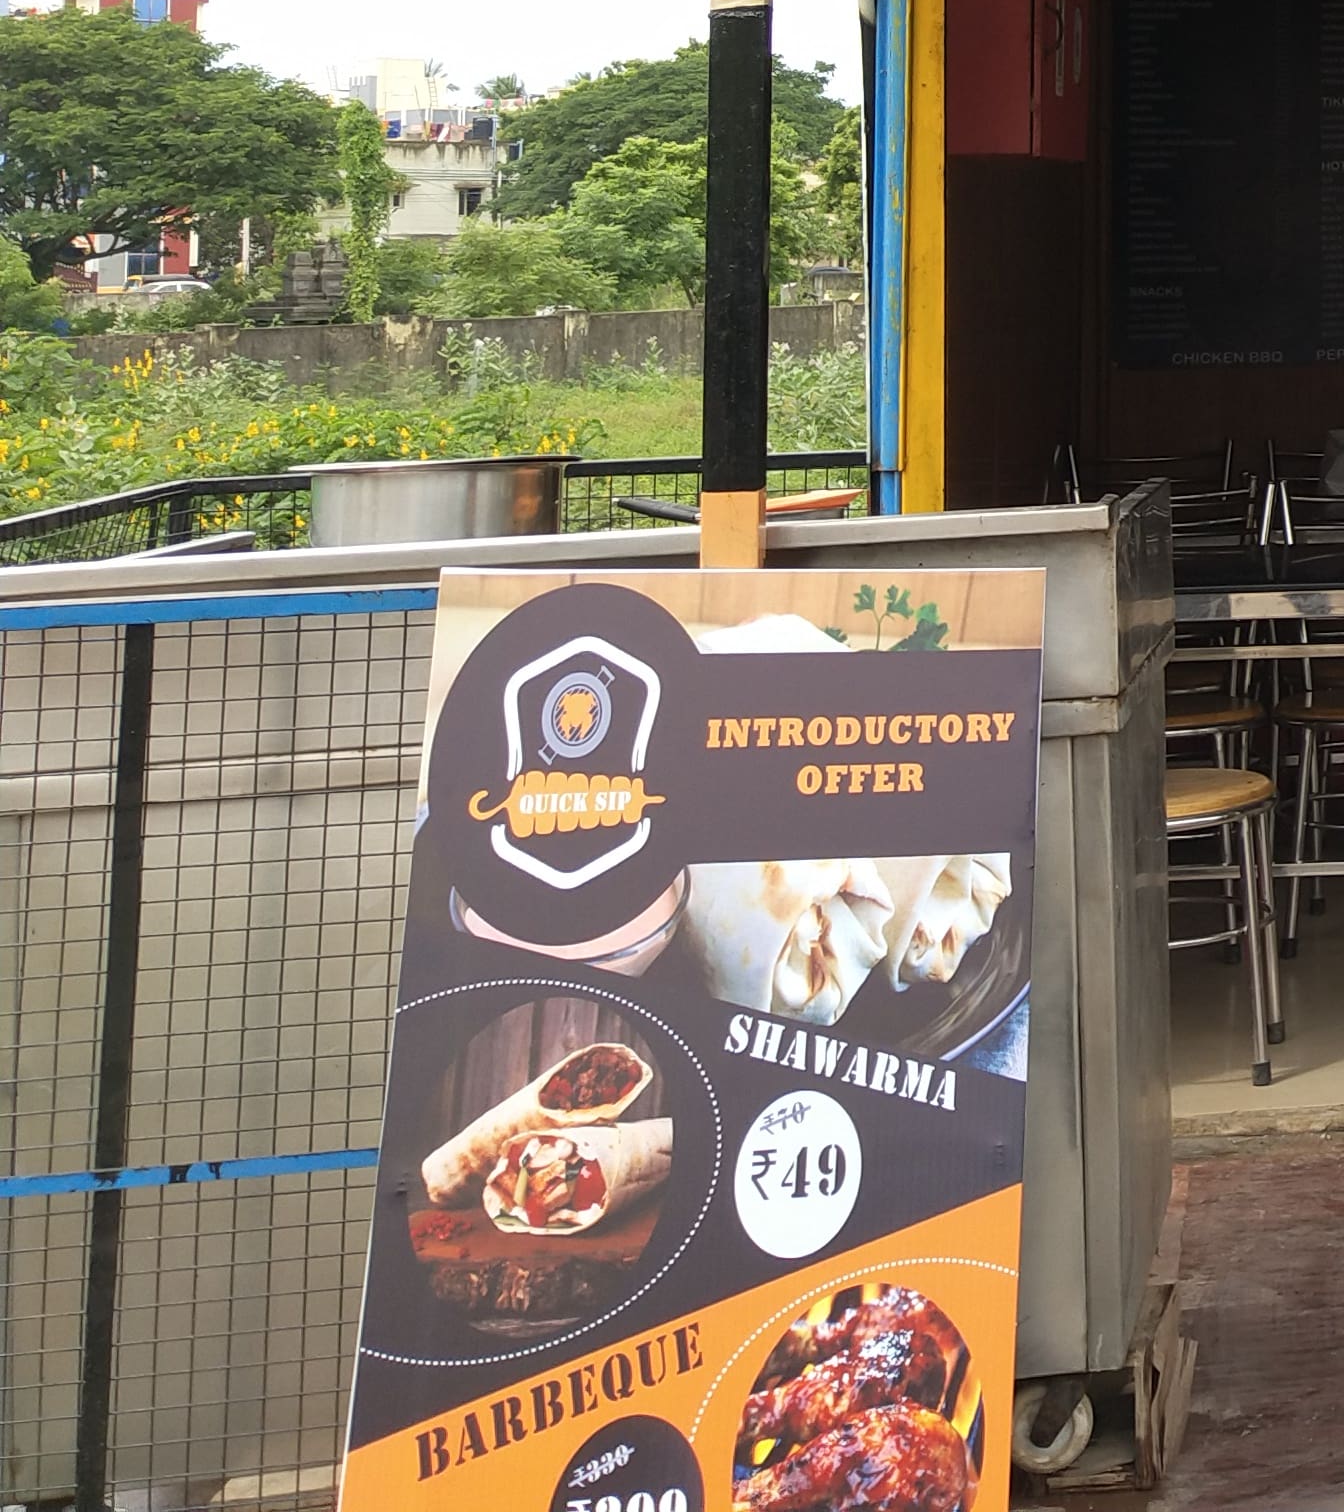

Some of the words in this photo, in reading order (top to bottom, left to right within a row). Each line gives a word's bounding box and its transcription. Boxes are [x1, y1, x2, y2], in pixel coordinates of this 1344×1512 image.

[1172, 351, 1244, 365] CHICKEN
[1249, 350, 1284, 364] BBQ
[705, 712, 1016, 751] INTRODUCTORY
[795, 761, 925, 796] OFFER
[519, 791, 589, 815] QUICK
[593, 790, 632, 812] SIP
[723, 1012, 958, 1113] SHAWARMA
[413, 1322, 704, 1483] BARBEQUE
